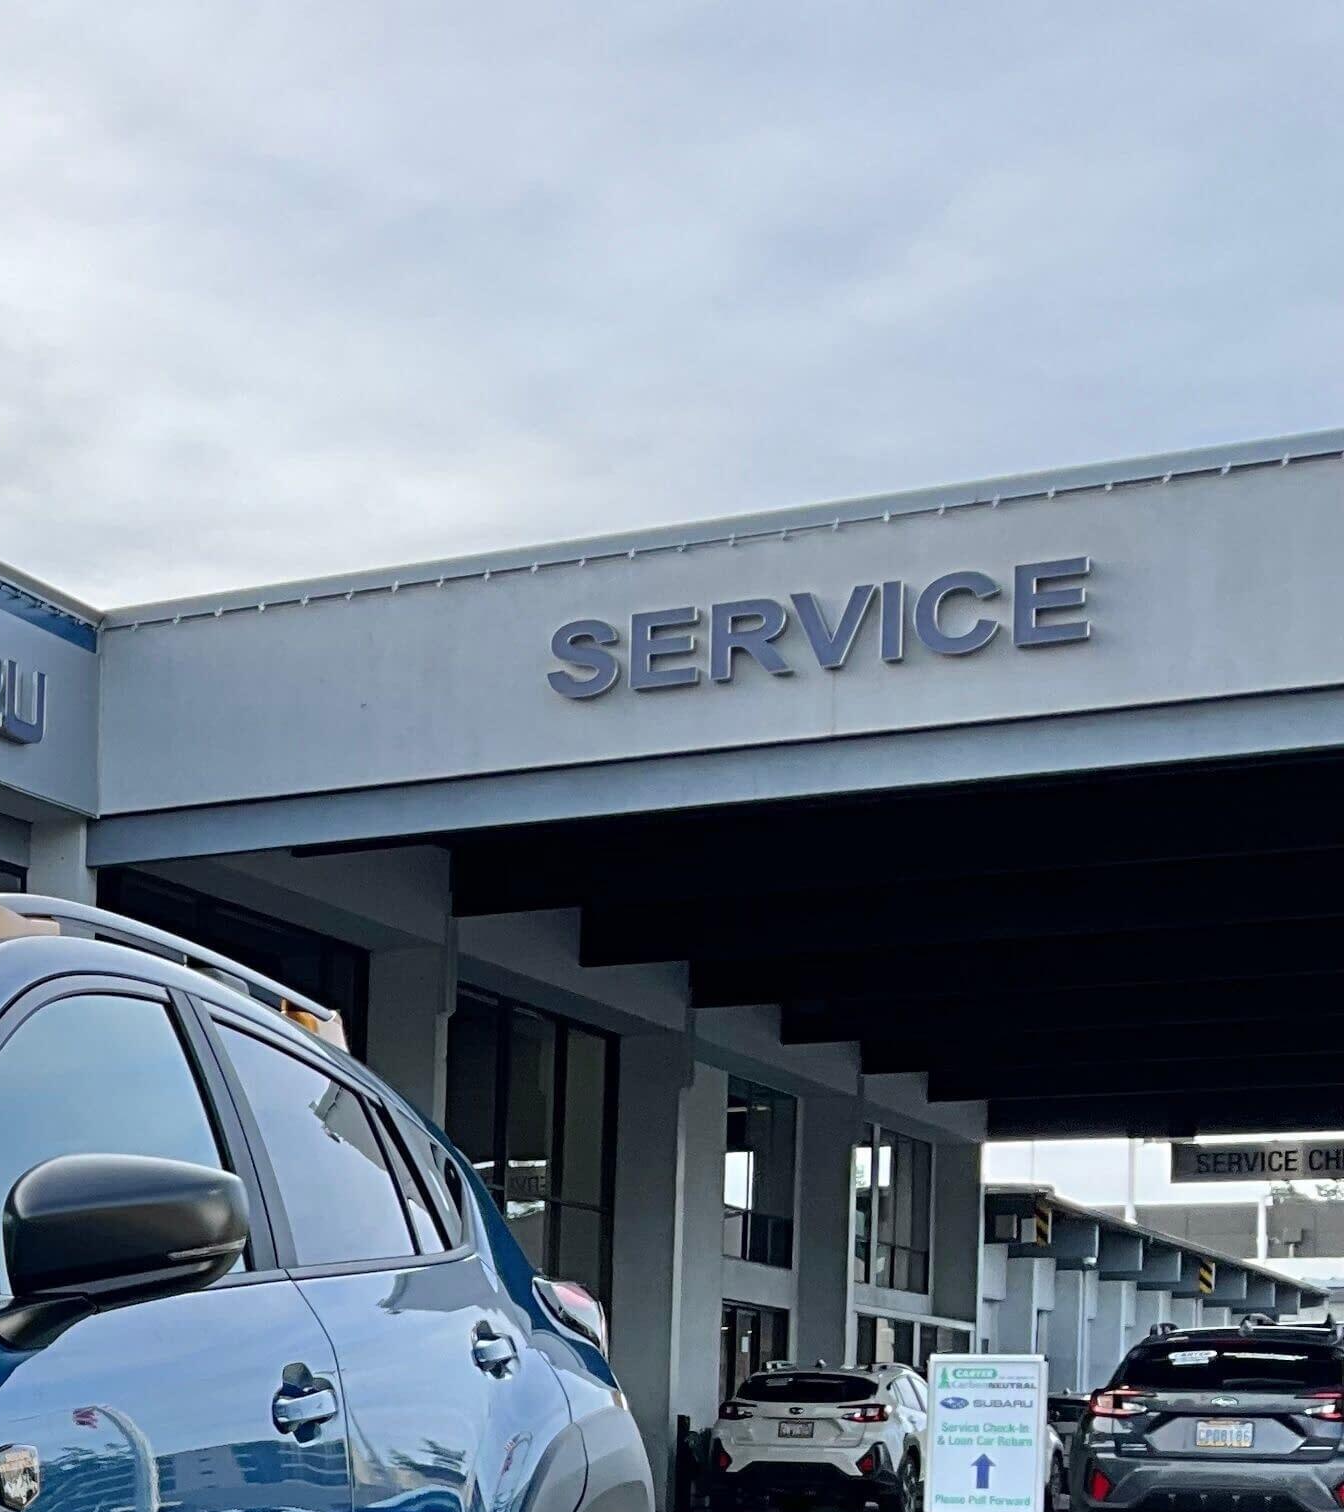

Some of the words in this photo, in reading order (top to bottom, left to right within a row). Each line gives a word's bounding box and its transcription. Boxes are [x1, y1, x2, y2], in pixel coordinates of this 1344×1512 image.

[547, 556, 1092, 700] SERVICE
[1196, 1149, 1298, 1174] SERVICE
[1308, 1148, 1344, 1171] CH
[973, 1399, 1033, 1408] SUBARU
[941, 1422, 979, 1433] Service
[937, 1435, 945, 1445] &
[949, 1435, 973, 1445] Loan
[976, 1436, 994, 1445] Car
[997, 1436, 1033, 1446] Return
[935, 1494, 965, 1505] Please
[968, 1495, 986, 1504] Pull
[990, 1496, 1031, 1506] Forward
